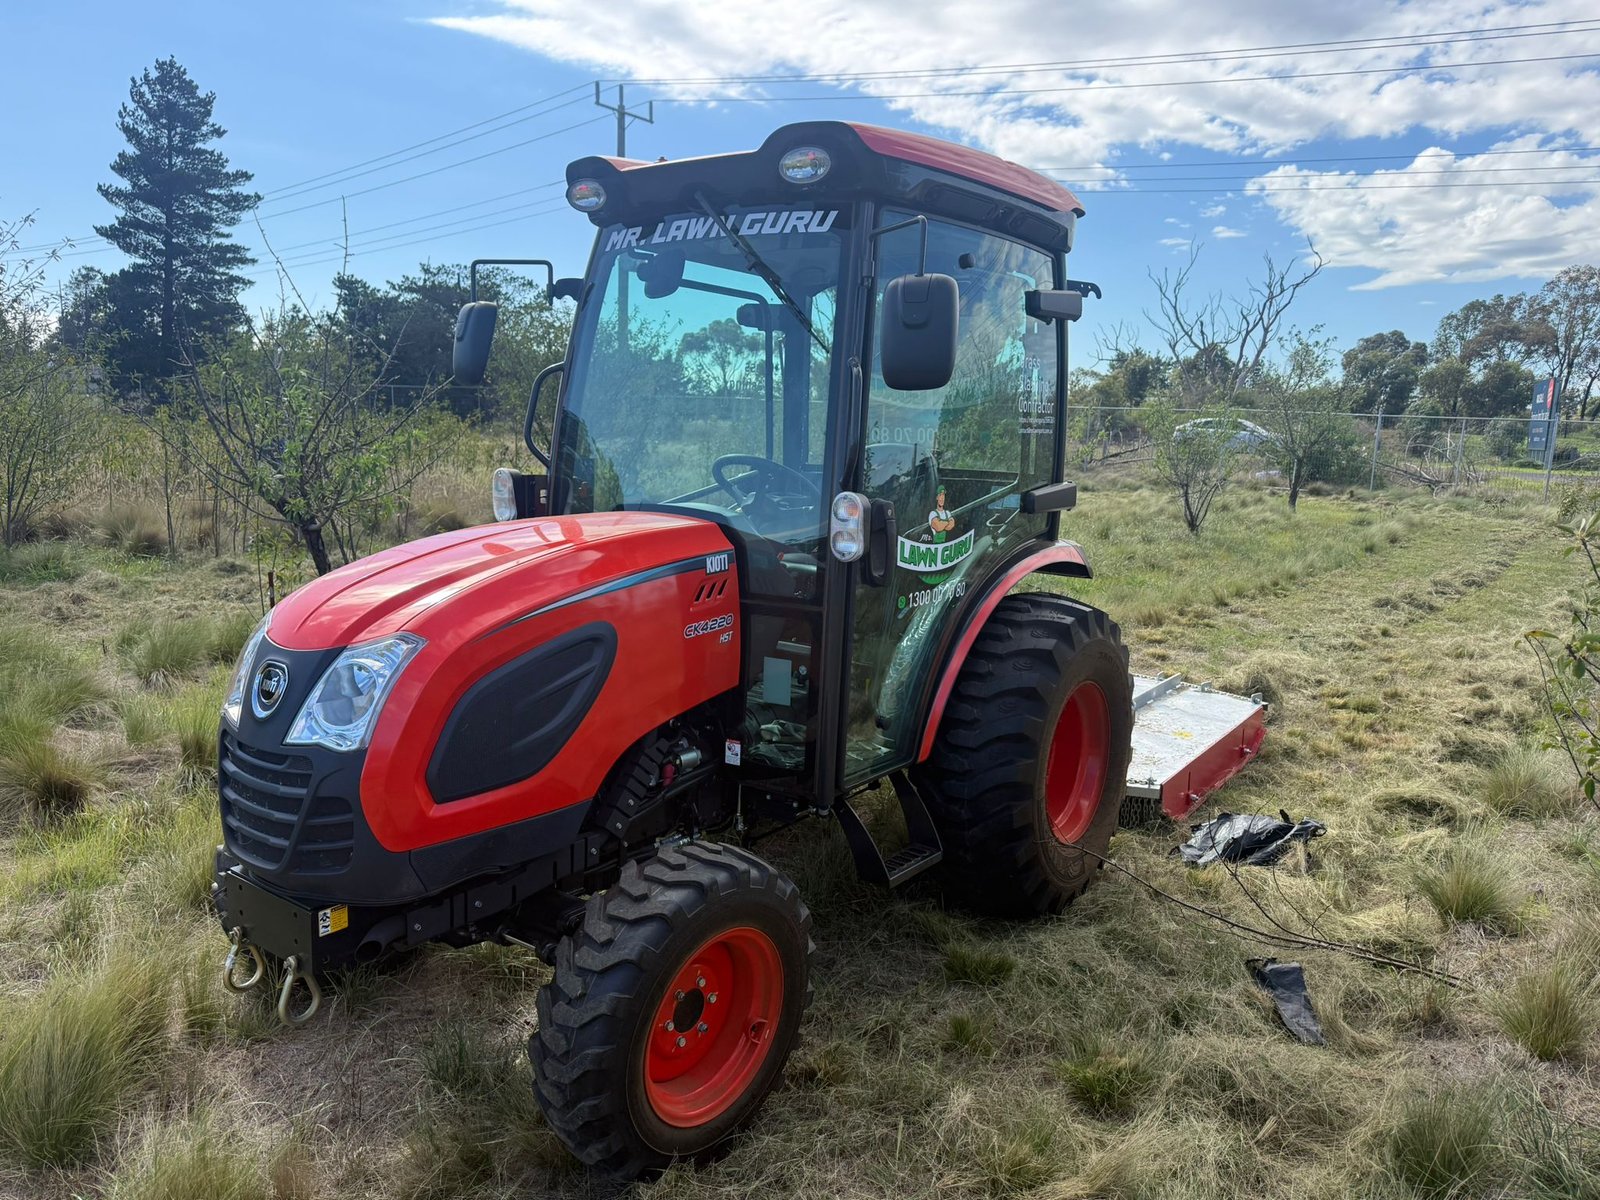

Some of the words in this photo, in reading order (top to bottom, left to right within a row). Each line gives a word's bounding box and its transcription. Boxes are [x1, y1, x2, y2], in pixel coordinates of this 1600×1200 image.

[605, 227, 646, 251] MR.
[651, 214, 737, 244] LAWN
[738, 210, 839, 236] GURU
[1018, 374, 1050, 396] Slahing
[1018, 397, 1054, 414] Contractor
[900, 540, 939, 568] LAWN
[940, 533, 973, 566] GURU
[706, 553, 728, 574] KIOTI
[908, 589, 931, 609] 1300
[955, 581, 966, 598] 80
[684, 613, 735, 639] CK4220
[719, 630, 734, 644] HST
